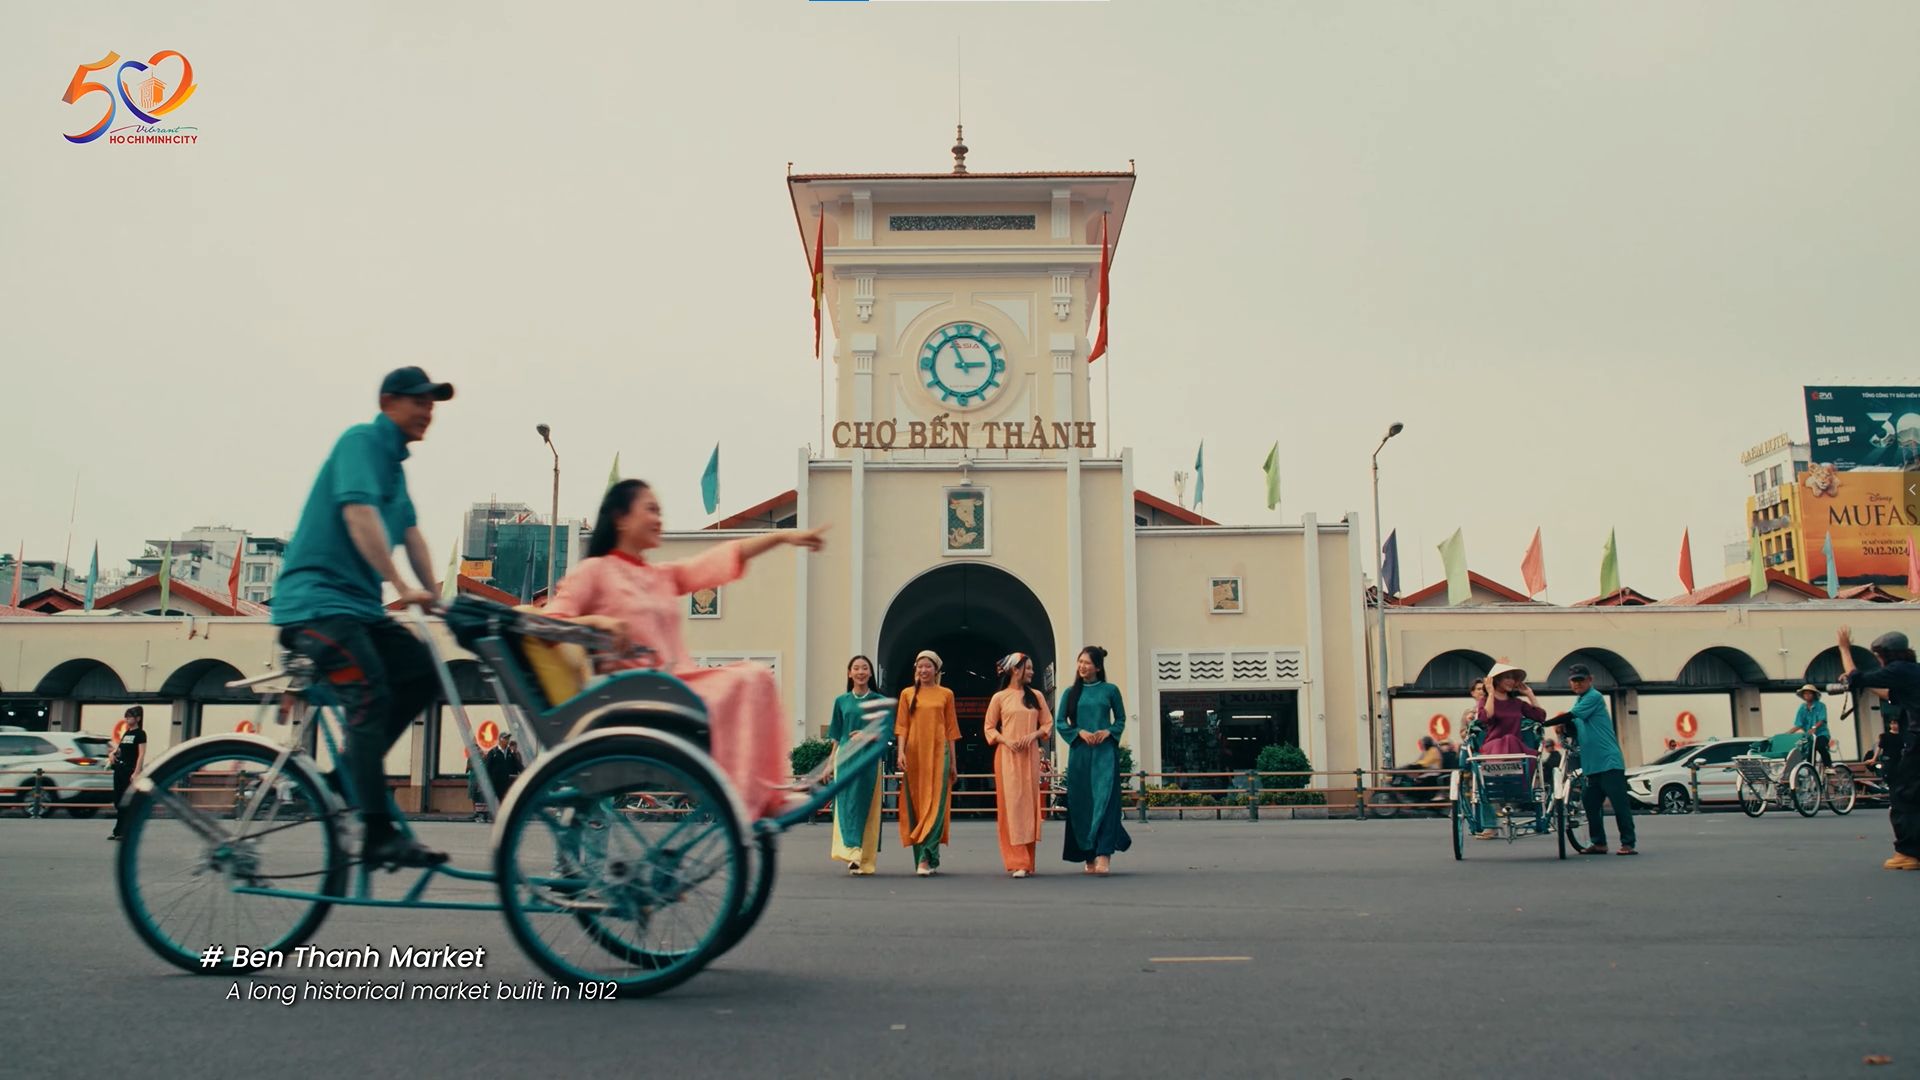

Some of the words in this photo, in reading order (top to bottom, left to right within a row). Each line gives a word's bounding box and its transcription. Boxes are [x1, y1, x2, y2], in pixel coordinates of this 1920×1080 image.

[832, 418, 897, 451] CHỢ
[908, 412, 970, 448] BẾN
[981, 416, 1097, 449] THÀNH
[1829, 504, 1920, 526] MUFAS
